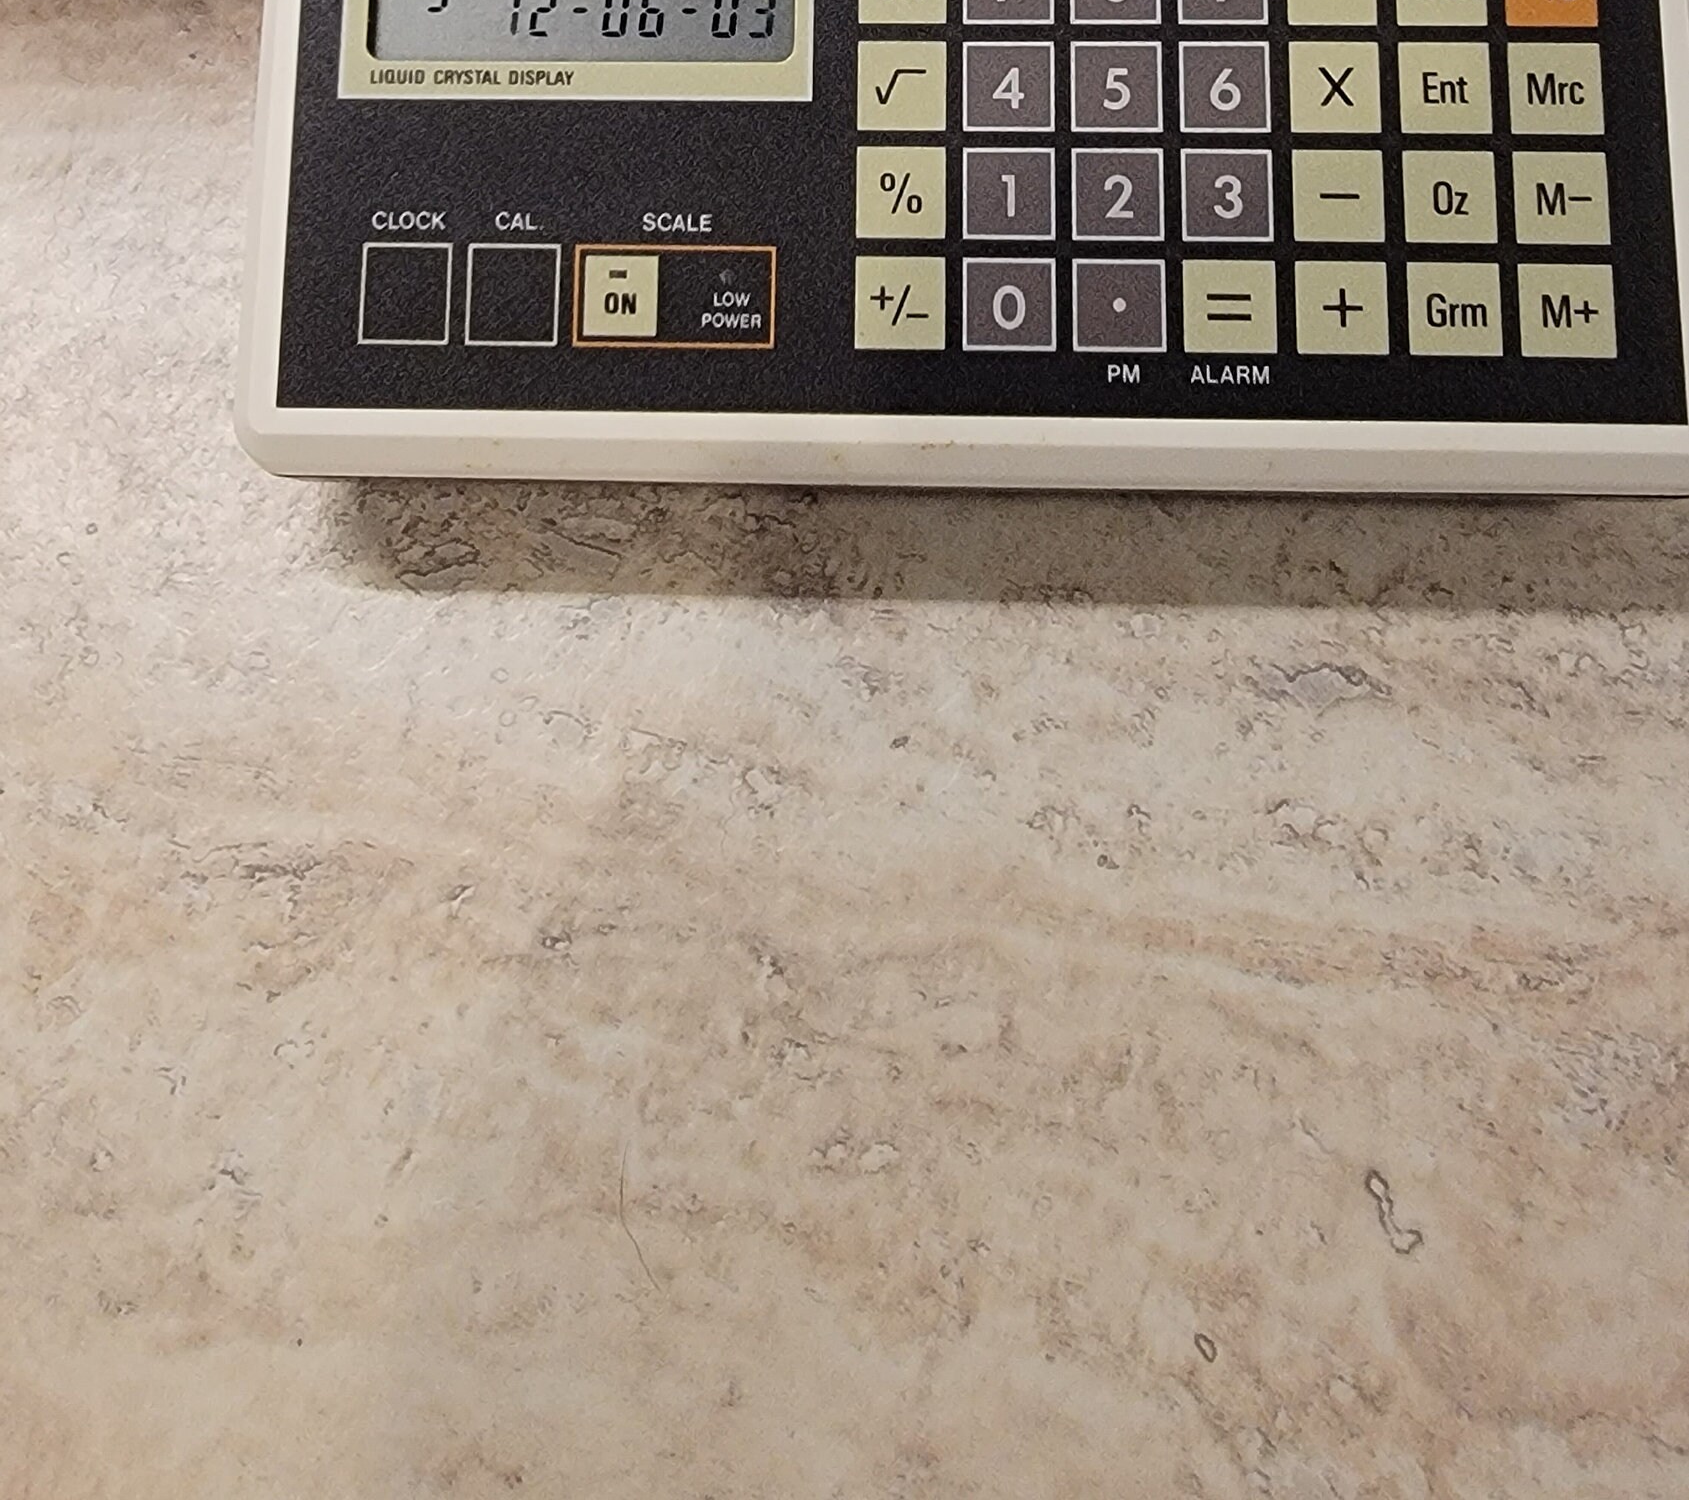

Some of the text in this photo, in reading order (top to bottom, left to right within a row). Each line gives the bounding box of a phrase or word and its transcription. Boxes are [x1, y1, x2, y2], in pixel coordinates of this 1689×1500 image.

[370, 69, 574, 86] LIQUID CRYSTAL DISPLAY
[992, 67, 1025, 109] 4
[1103, 67, 1131, 110] 5
[1209, 68, 1241, 111] 6
[1422, 71, 1469, 104] Ent
[1526, 72, 1585, 105] Mrc
[880, 172, 923, 214] %
[1001, 174, 1016, 218] 1
[1103, 174, 1134, 219] 2
[1213, 174, 1243, 219] 3
[371, 210, 446, 230] CLOCK
[642, 212, 712, 232] SCALE
[604, 292, 637, 315] ON
[713, 291, 751, 307] LOW
[1426, 293, 1488, 328] Grm
[1541, 294, 1599, 328] M+
[701, 312, 762, 329] POWER
[1107, 363, 1140, 383] PM
[1190, 364, 1270, 385] ALARM
